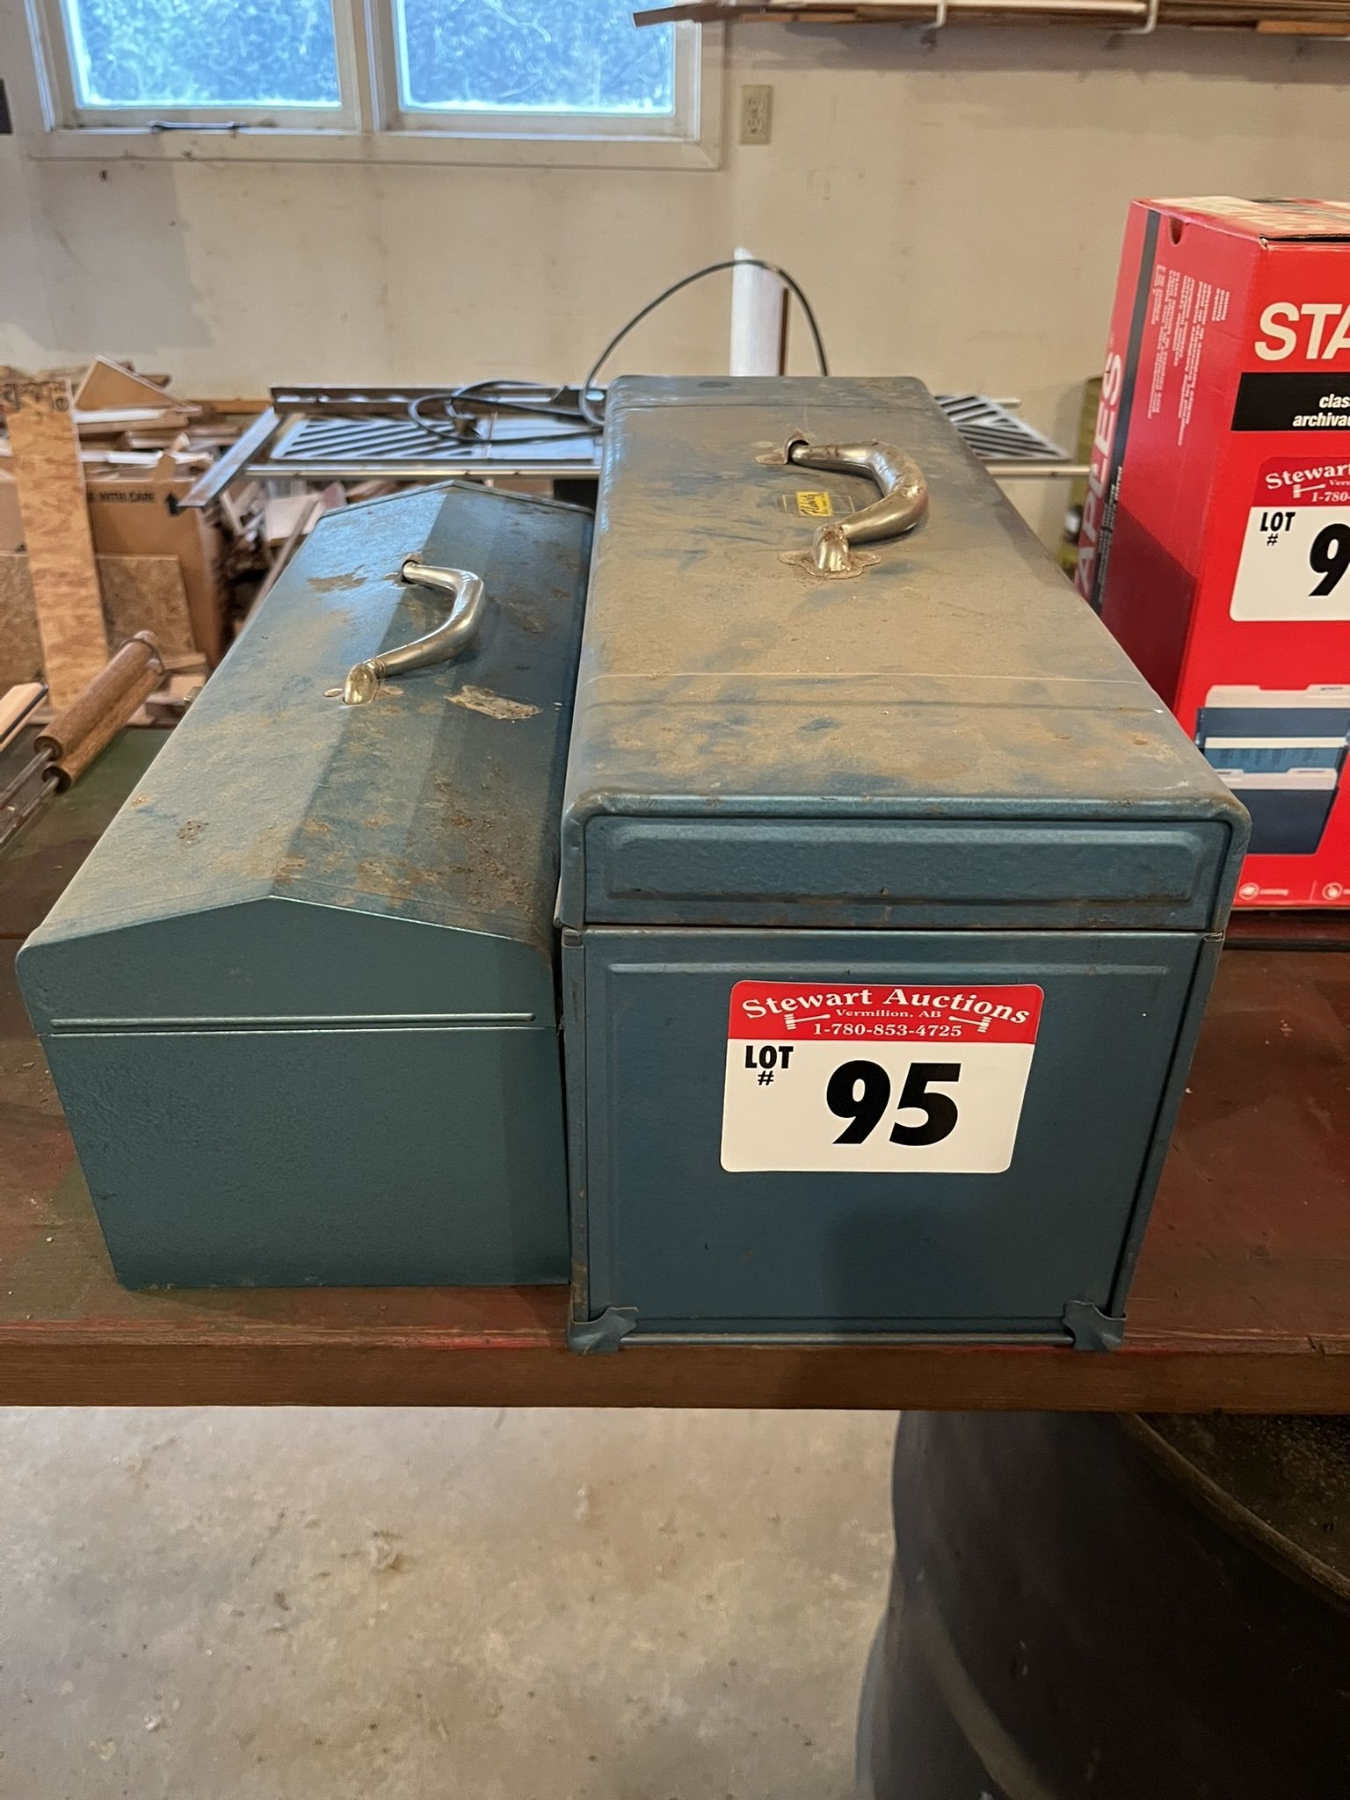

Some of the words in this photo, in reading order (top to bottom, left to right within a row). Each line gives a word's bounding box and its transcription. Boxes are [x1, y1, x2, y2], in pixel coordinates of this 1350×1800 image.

[1292, 411, 1350, 427] archiva
[1077, 352, 1124, 596] APLES
[1259, 511, 1296, 532] LOT
[1266, 533, 1279, 547] #
[1308, 523, 1350, 597] 9
[742, 989, 873, 1019] Stewart
[882, 988, 1030, 1024] Auctions
[918, 1010, 942, 1018] AB
[813, 1023, 963, 1037] 1-780-853-4725
[745, 1045, 794, 1069] LOT
[757, 1070, 775, 1086] #
[826, 1060, 961, 1146] 95
